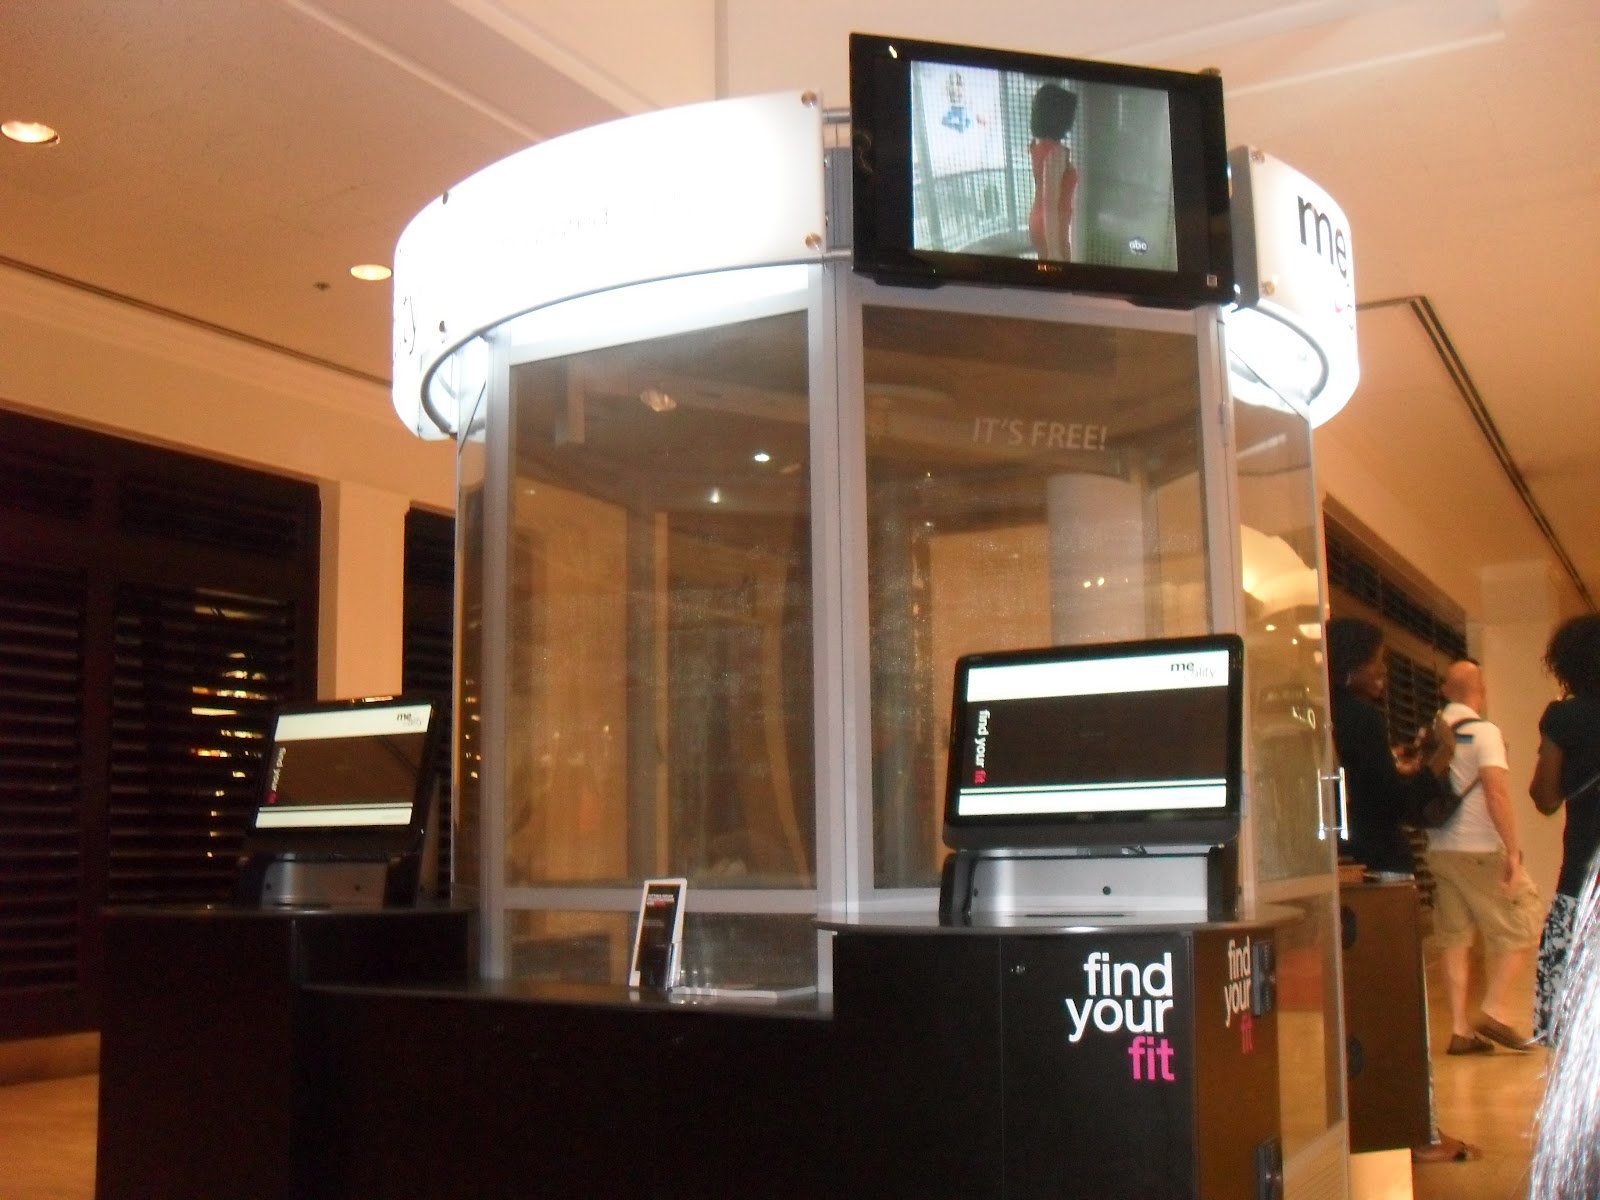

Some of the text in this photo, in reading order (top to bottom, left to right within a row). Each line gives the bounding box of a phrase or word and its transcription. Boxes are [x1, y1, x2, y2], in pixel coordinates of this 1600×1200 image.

[1297, 195, 1347, 279] me
[973, 417, 1108, 450] IT'S FREE!
[1171, 662, 1194, 672] me
[978, 709, 991, 736] find
[974, 737, 987, 768] your
[1083, 952, 1174, 997] find
[1227, 936, 1252, 981] find
[1065, 998, 1174, 1044] your
[1224, 977, 1252, 1029] your
[1127, 1035, 1176, 1082] fit
